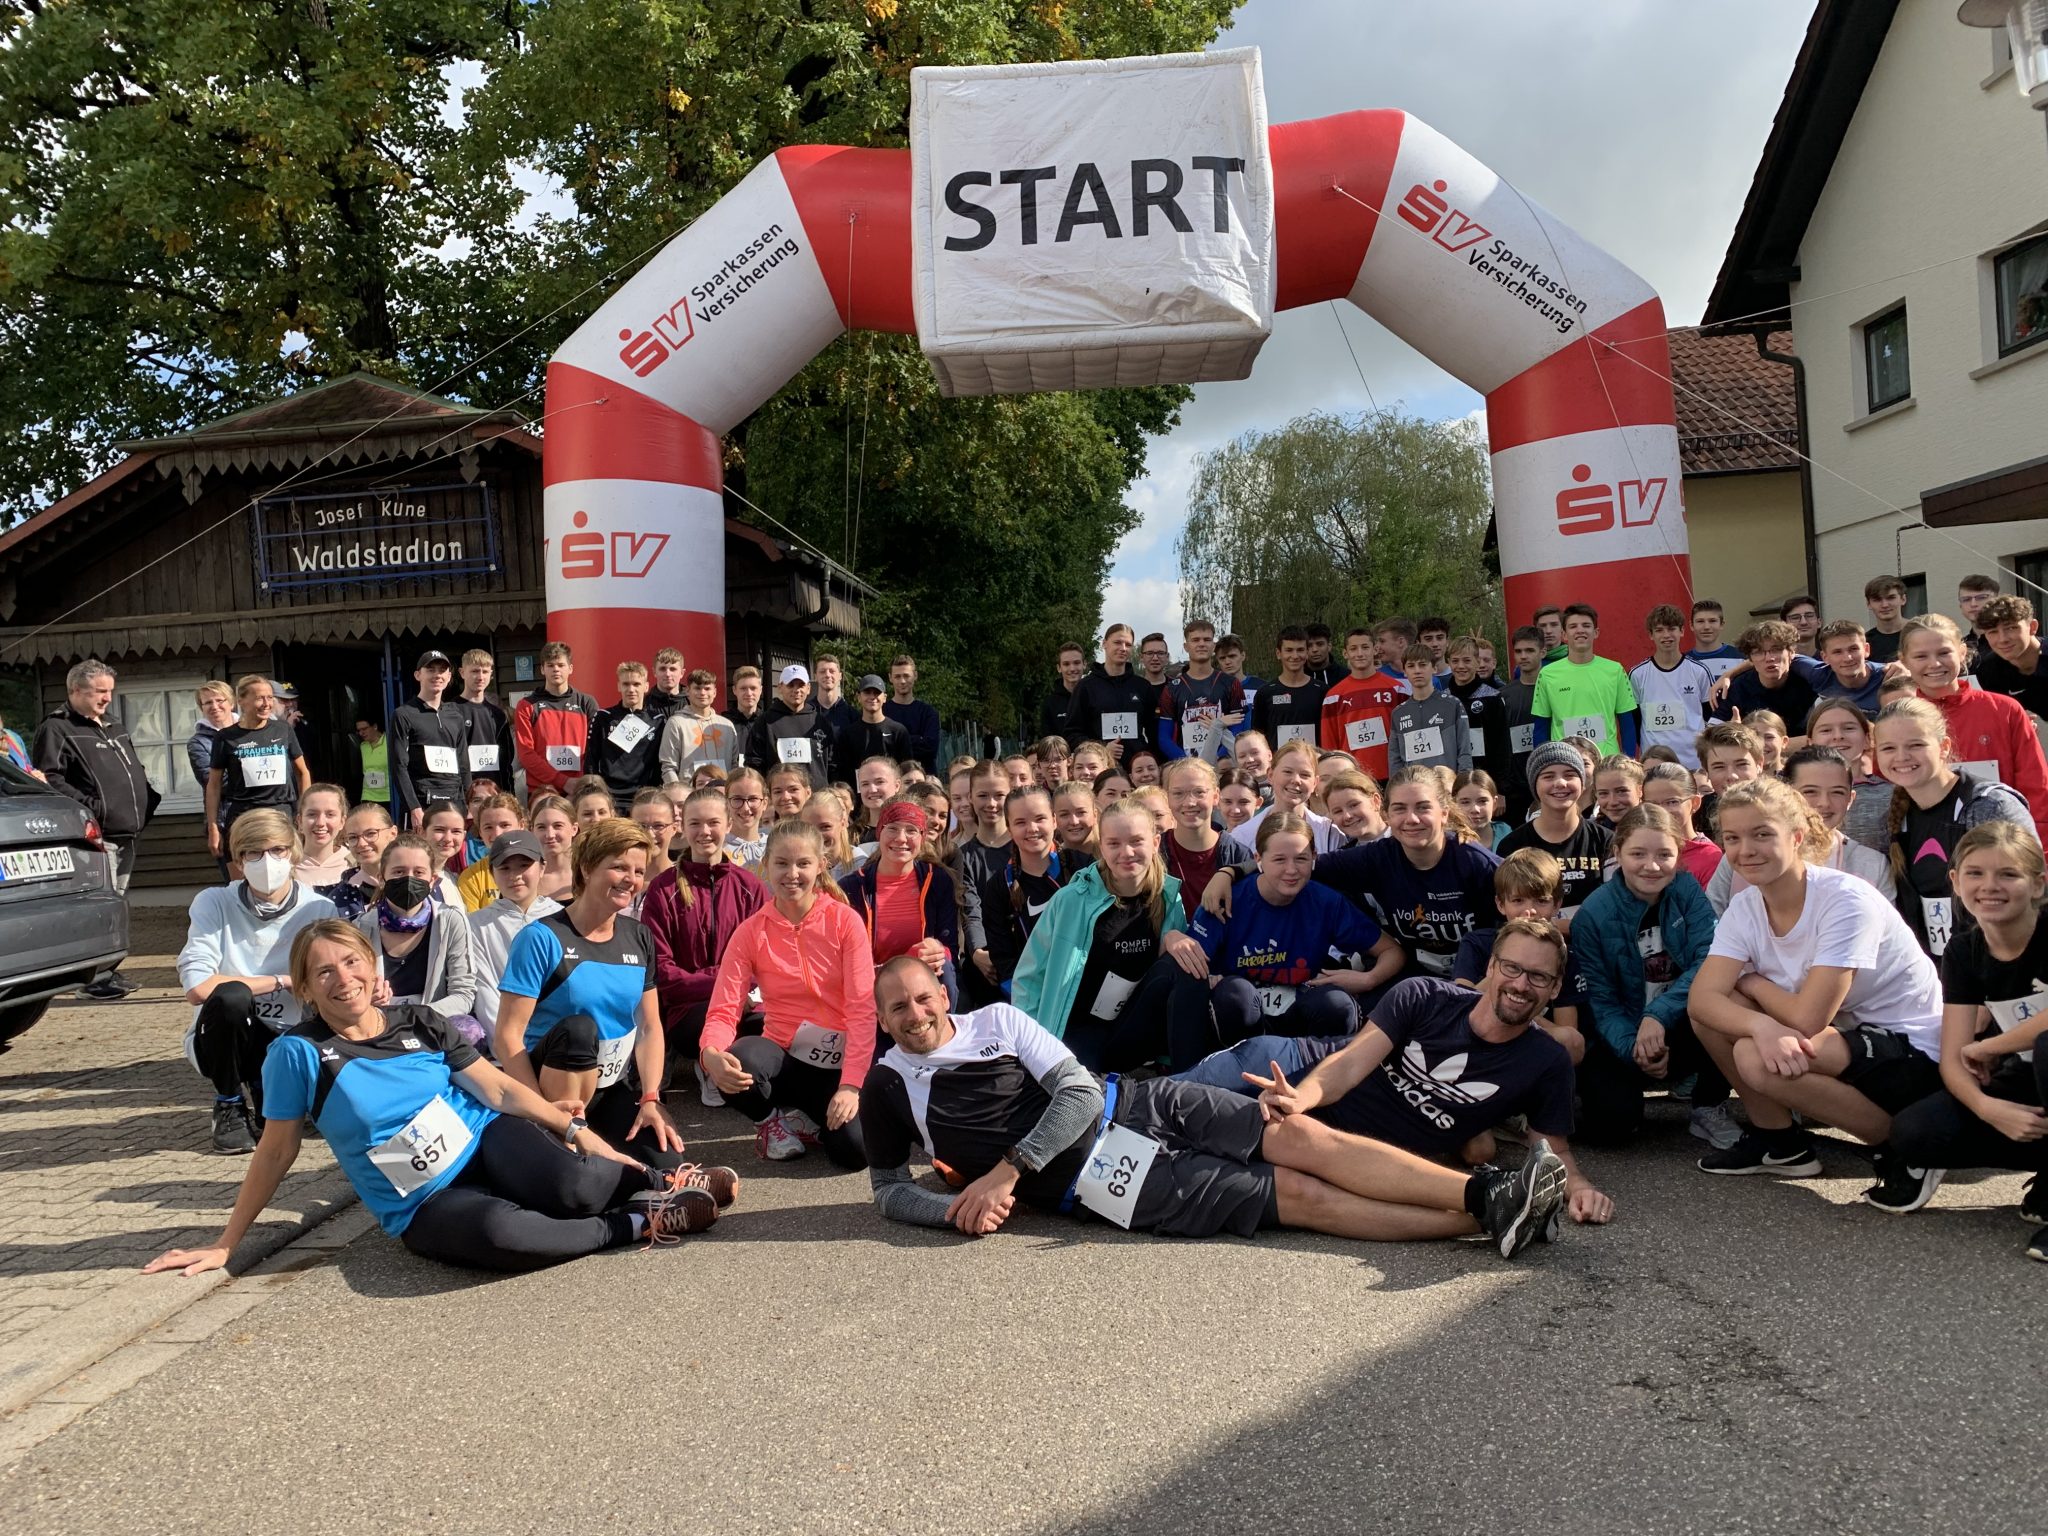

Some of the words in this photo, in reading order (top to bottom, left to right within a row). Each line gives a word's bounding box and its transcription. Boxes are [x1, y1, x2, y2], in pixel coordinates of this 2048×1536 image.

[944, 156, 1245, 252] START
[691, 223, 783, 302] Sparkassen
[695, 238, 800, 324] Versicherung
[1489, 240, 1588, 314] Sparkassen
[1467, 248, 1575, 334] Versicherung
[315, 503, 363, 526] Josef
[292, 538, 462, 572] Waldstadion
[1373, 691, 1392, 703] 13
[1654, 716, 1675, 726] 523
[625, 726, 640, 742] 626
[1112, 725, 1129, 734] 612
[1358, 732, 1376, 743] 557
[1521, 737, 1533, 747] 52
[787, 750, 802, 758] 541
[1413, 742, 1432, 754] 521
[434, 758, 449, 768] 571
[478, 757, 494, 766] 692
[556, 757, 573, 766] 586
[256, 770, 276, 780] 717
[1, 855, 20, 877] KA
[27, 852, 42, 874] AT
[44, 850, 70, 871] 1919
[1396, 908, 1463, 922] Volsbank
[1393, 912, 1475, 942] Lauf
[1929, 926, 1953, 943] 51
[1115, 939, 1151, 950] POMPEI
[622, 953, 639, 964] KW
[1259, 991, 1282, 1009] 14
[401, 1038, 421, 1049] BB
[980, 1043, 1000, 1058] MV
[809, 1047, 842, 1065] 579
[410, 1133, 449, 1171] 657
[1107, 1155, 1139, 1198] 632
